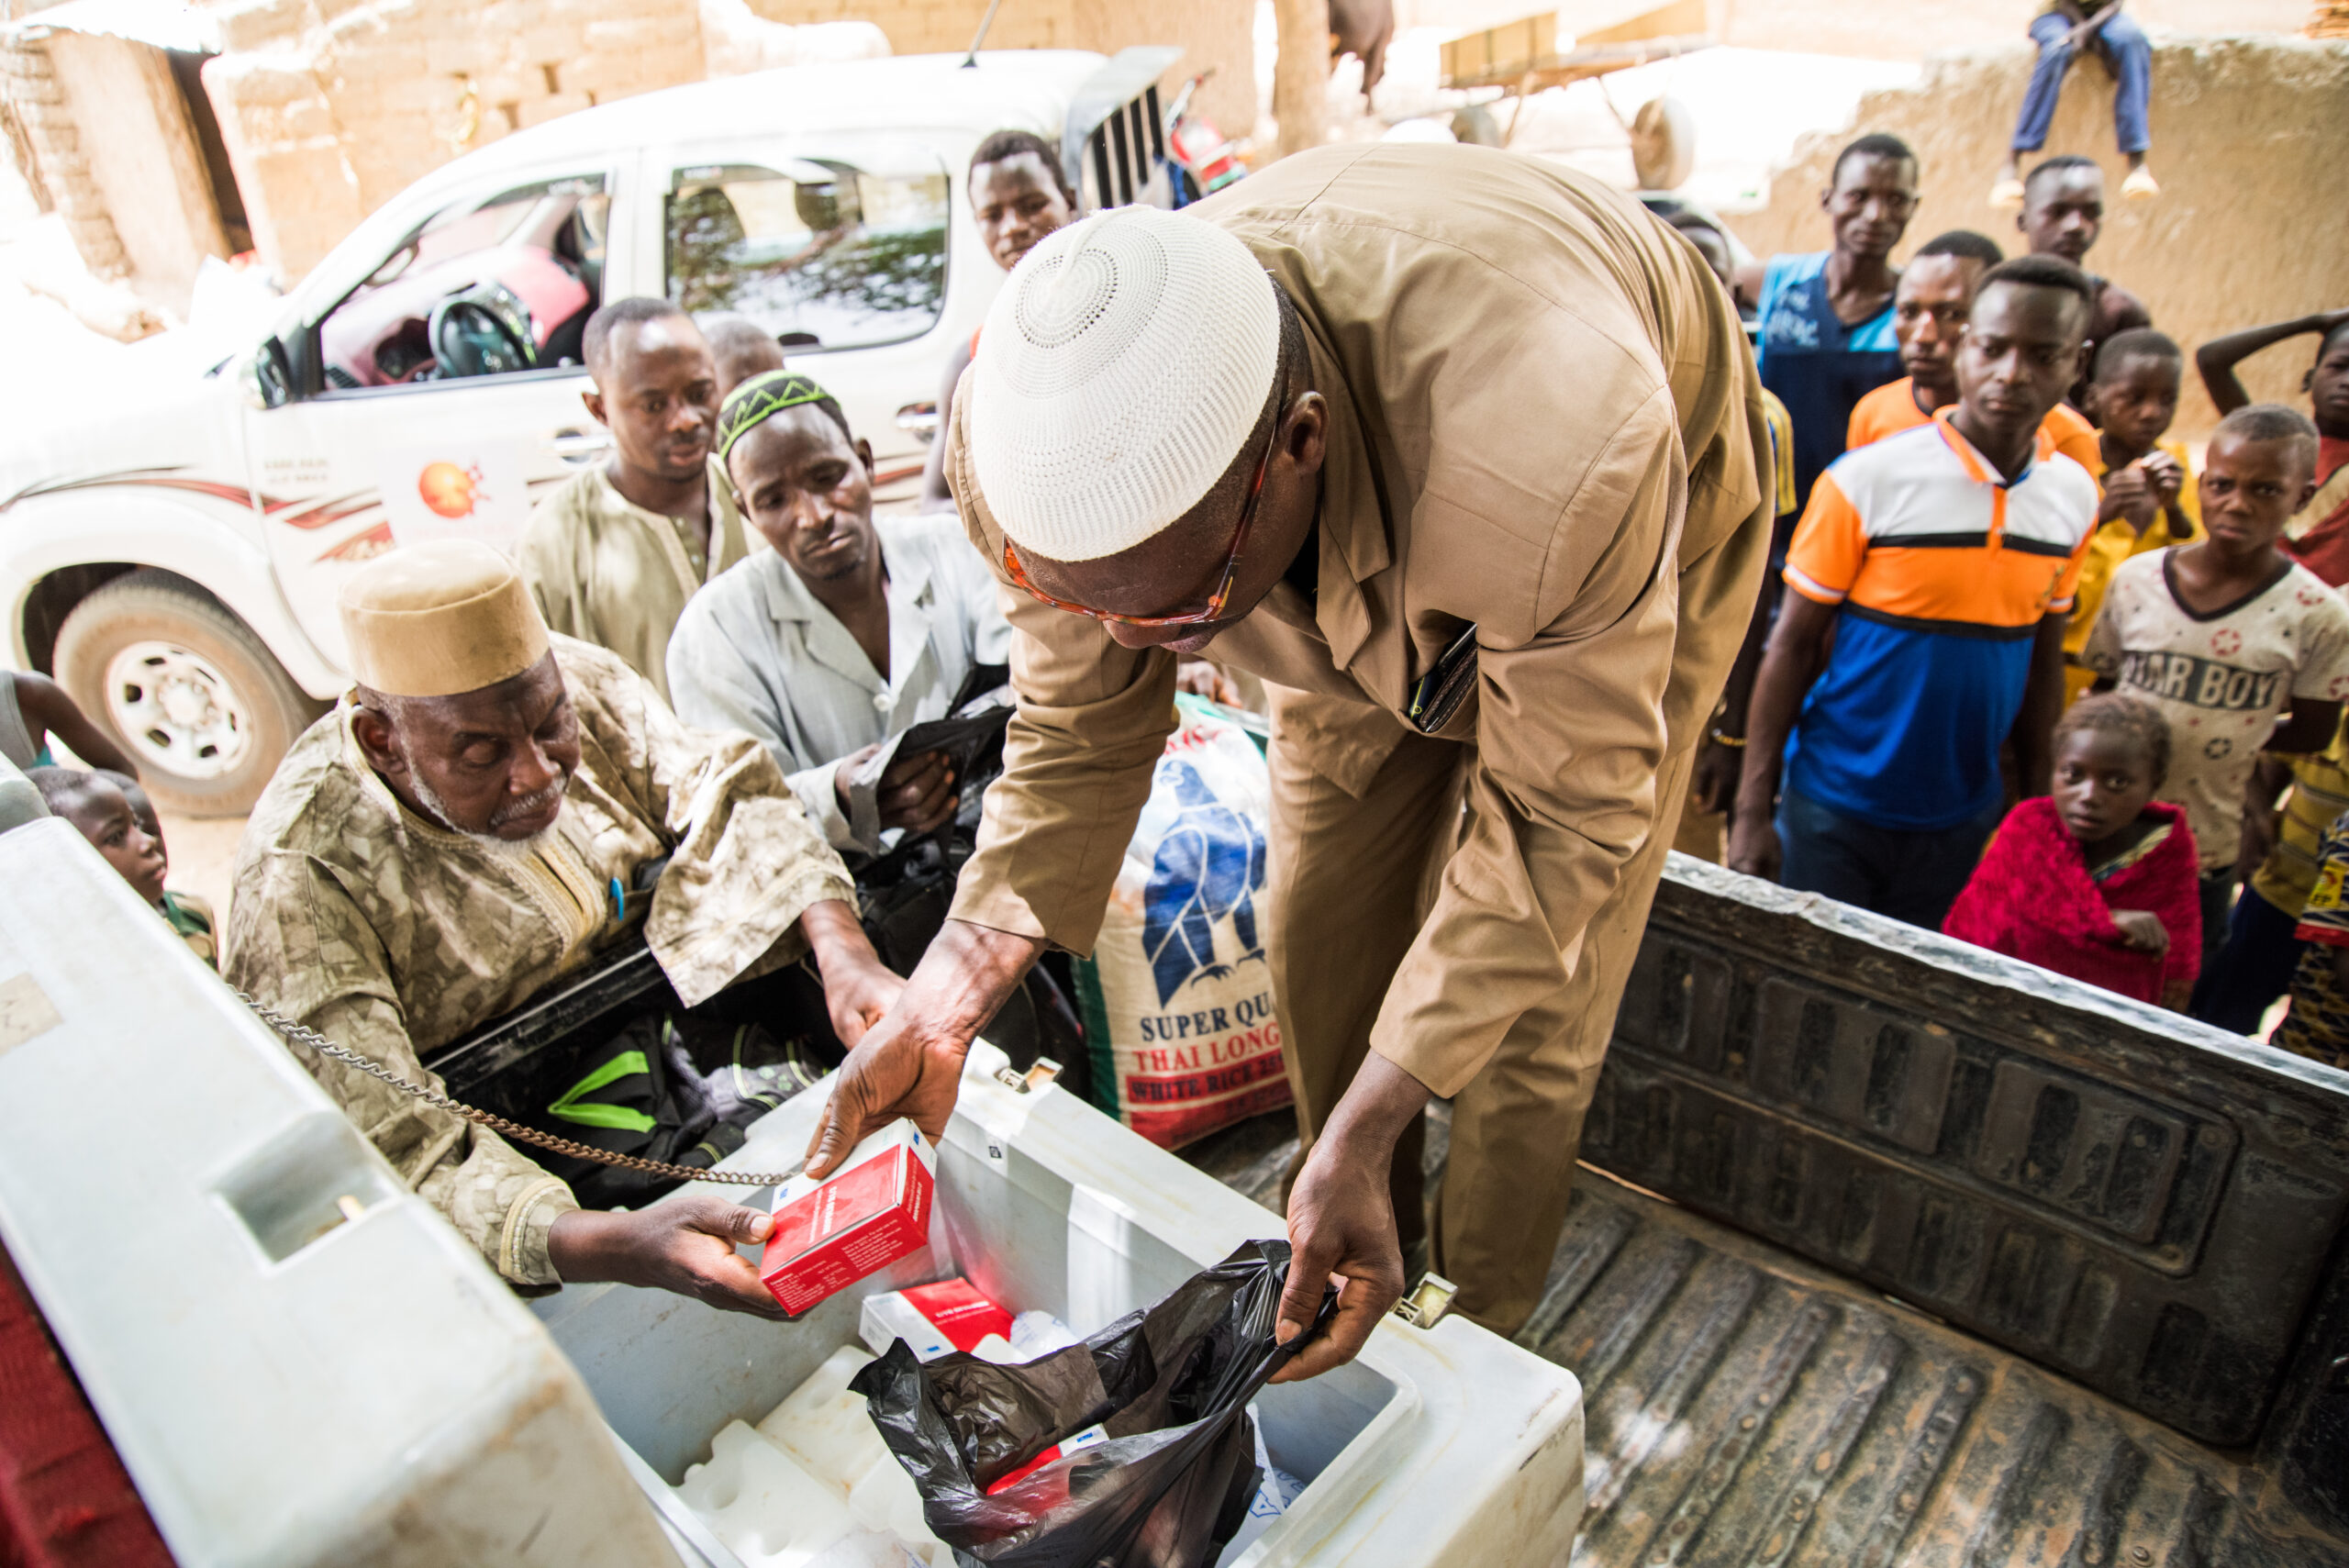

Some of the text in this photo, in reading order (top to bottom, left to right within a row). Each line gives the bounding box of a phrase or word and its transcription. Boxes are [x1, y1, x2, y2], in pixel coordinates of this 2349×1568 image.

[2198, 662, 2278, 708] BOY
[1140, 991, 1275, 1042] SUPER QU
[1132, 1022, 1280, 1073] THAI LONG
[1131, 1078, 1200, 1101] WHITE
[1206, 1063, 1252, 1094] RICE
